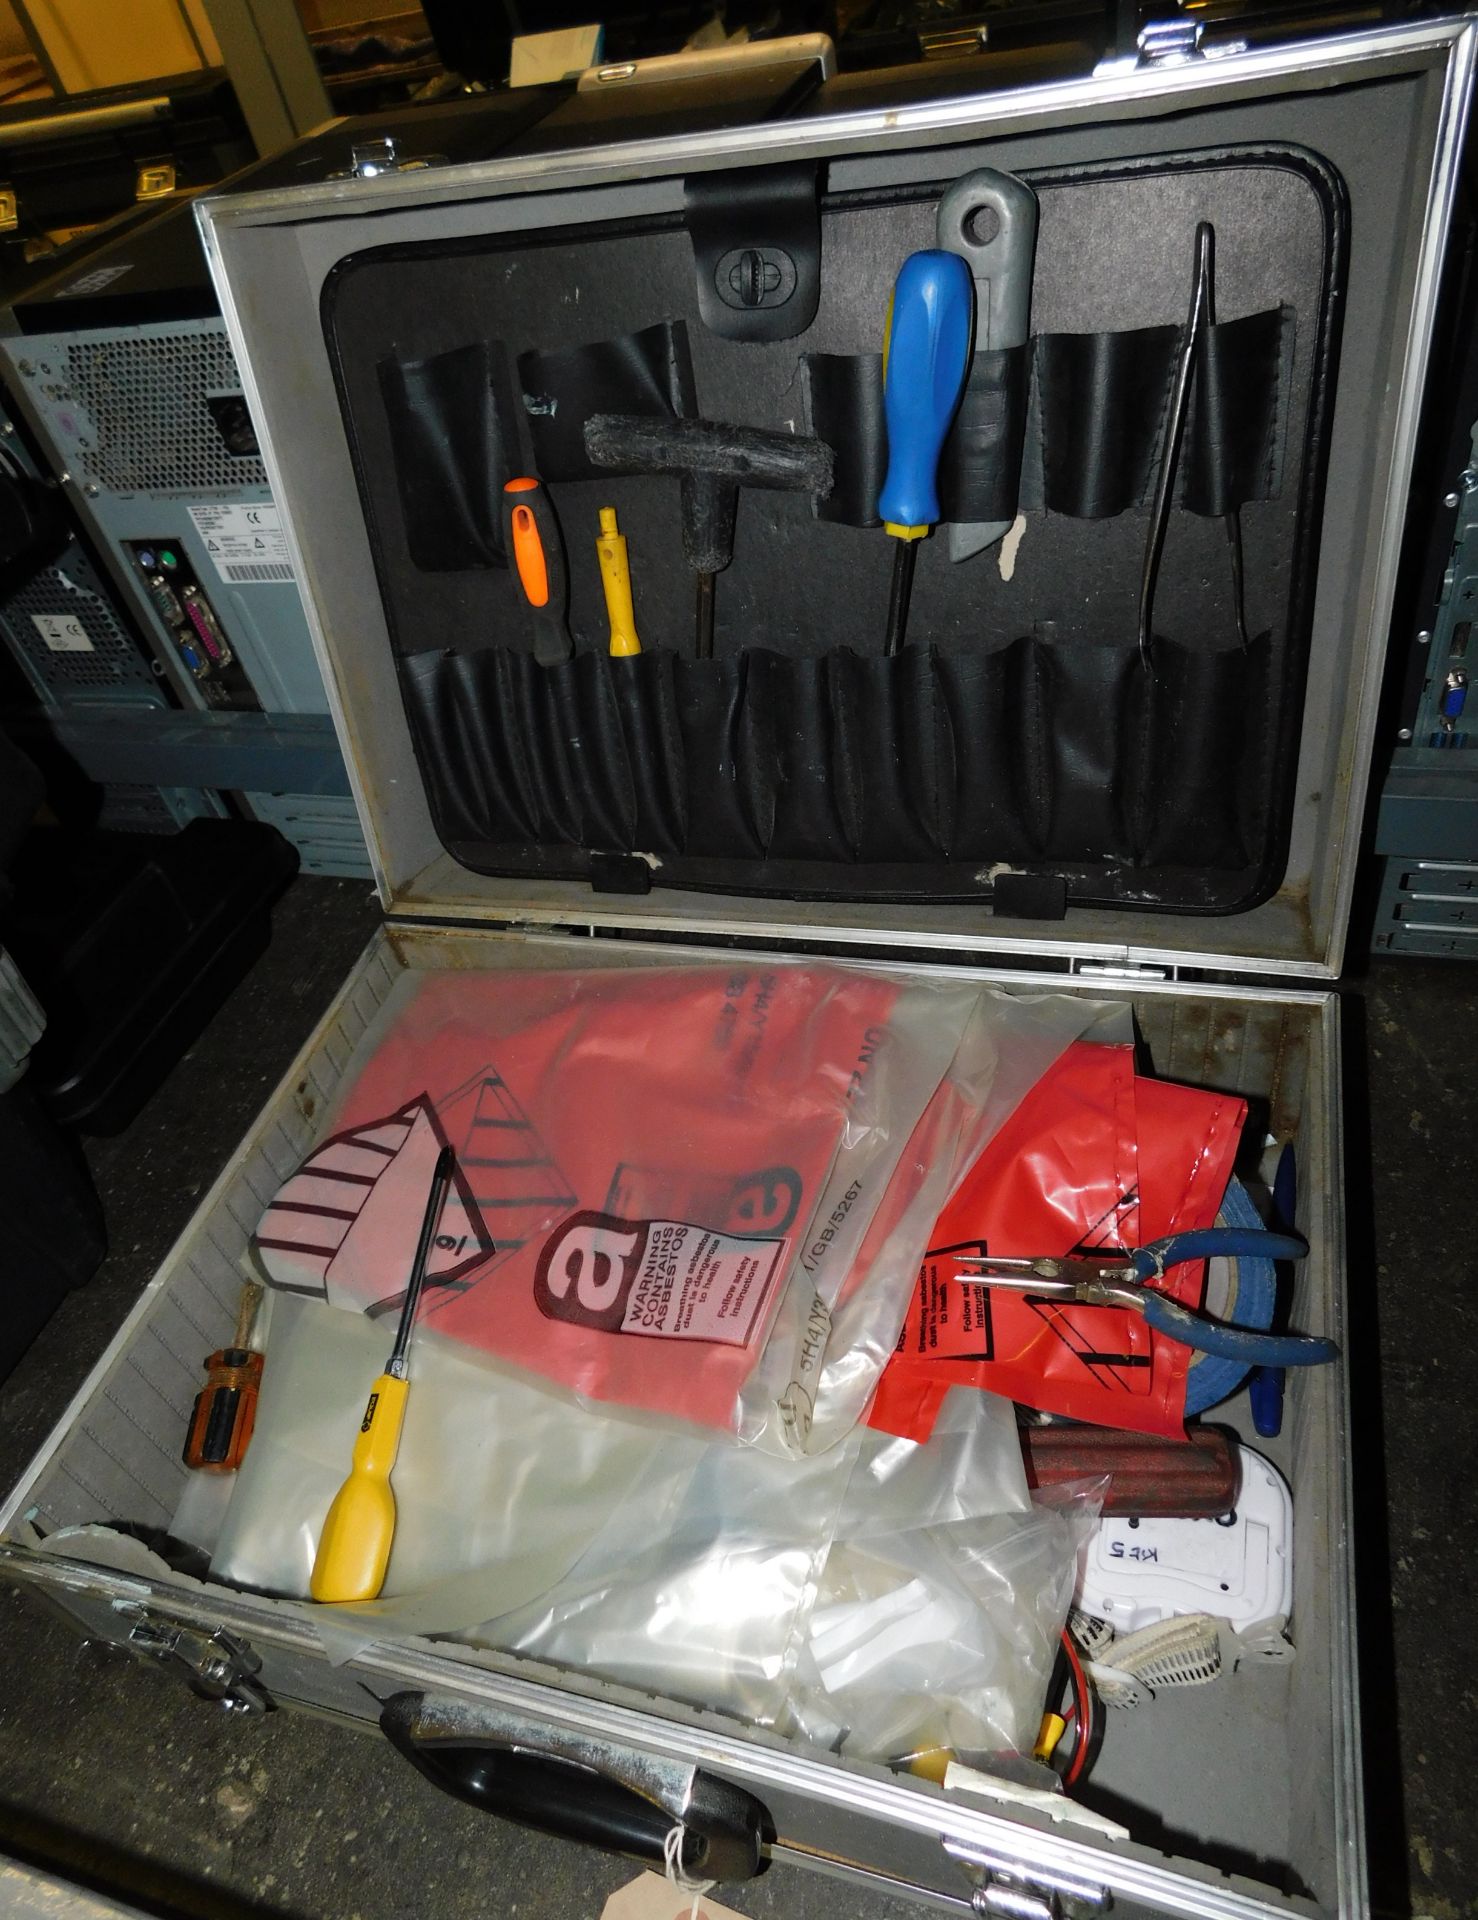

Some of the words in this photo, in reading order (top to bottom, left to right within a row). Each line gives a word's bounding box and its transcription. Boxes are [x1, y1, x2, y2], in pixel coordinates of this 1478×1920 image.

[547, 1225, 640, 1312] a
[629, 1230, 662, 1322] WARNING
[641, 1227, 673, 1327] CONTAINS
[654, 1227, 688, 1332] ASBESTOS
[674, 1277, 692, 1332] Breathing
[688, 1233, 711, 1274] asbestos
[694, 1239, 720, 1288] dangerous
[702, 1260, 722, 1290] health
[689, 1290, 698, 1301] is
[698, 1291, 707, 1303] to
[717, 1285, 737, 1319] Follow
[734, 1256, 751, 1284] safety
[684, 1303, 695, 1329] dust
[918, 1307, 929, 1353] Breathing
[940, 1314, 948, 1324] to
[962, 1300, 972, 1332] Follow
[1109, 1541, 1124, 1558] 5
